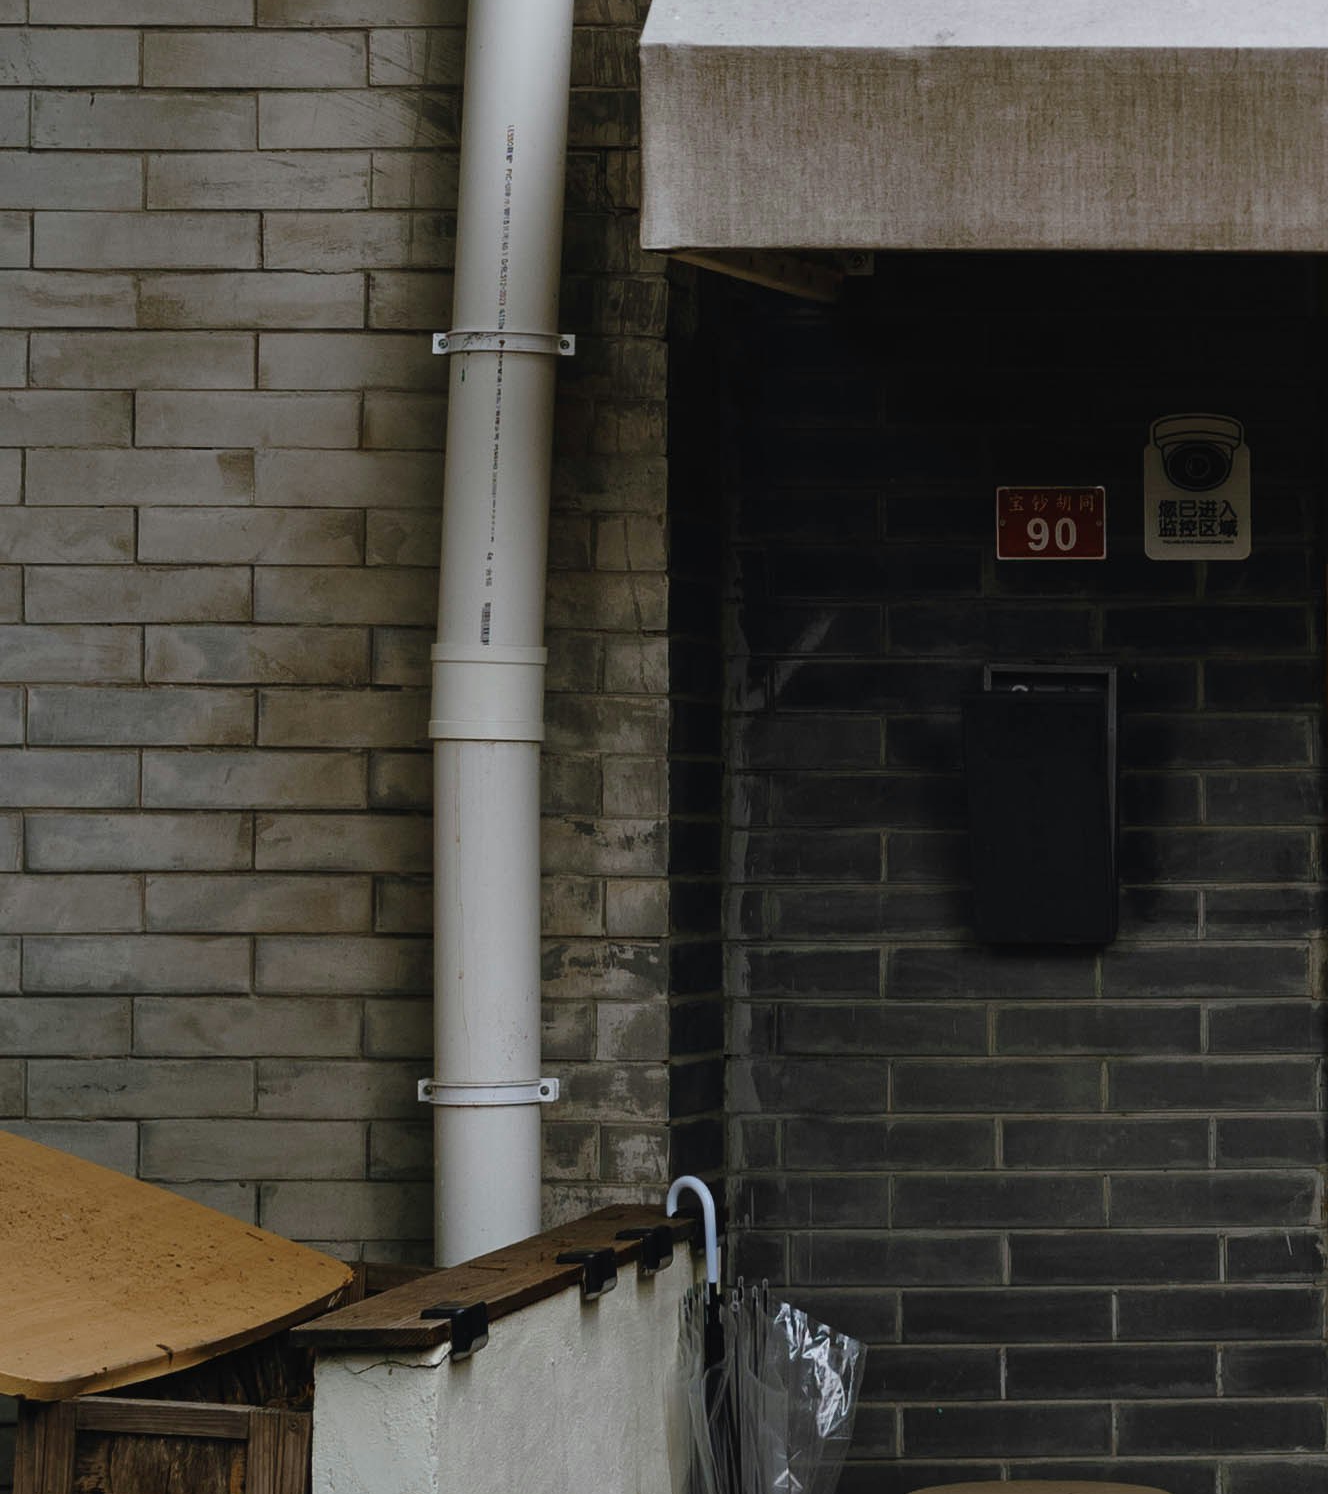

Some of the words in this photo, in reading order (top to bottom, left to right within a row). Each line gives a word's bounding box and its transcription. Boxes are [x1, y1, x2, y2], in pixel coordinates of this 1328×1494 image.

[1007, 493, 1096, 513] 宝钞胡同
[1158, 500, 1238, 519] 您已进入
[1026, 517, 1078, 551] 90
[1157, 519, 1239, 538] 监控区域
